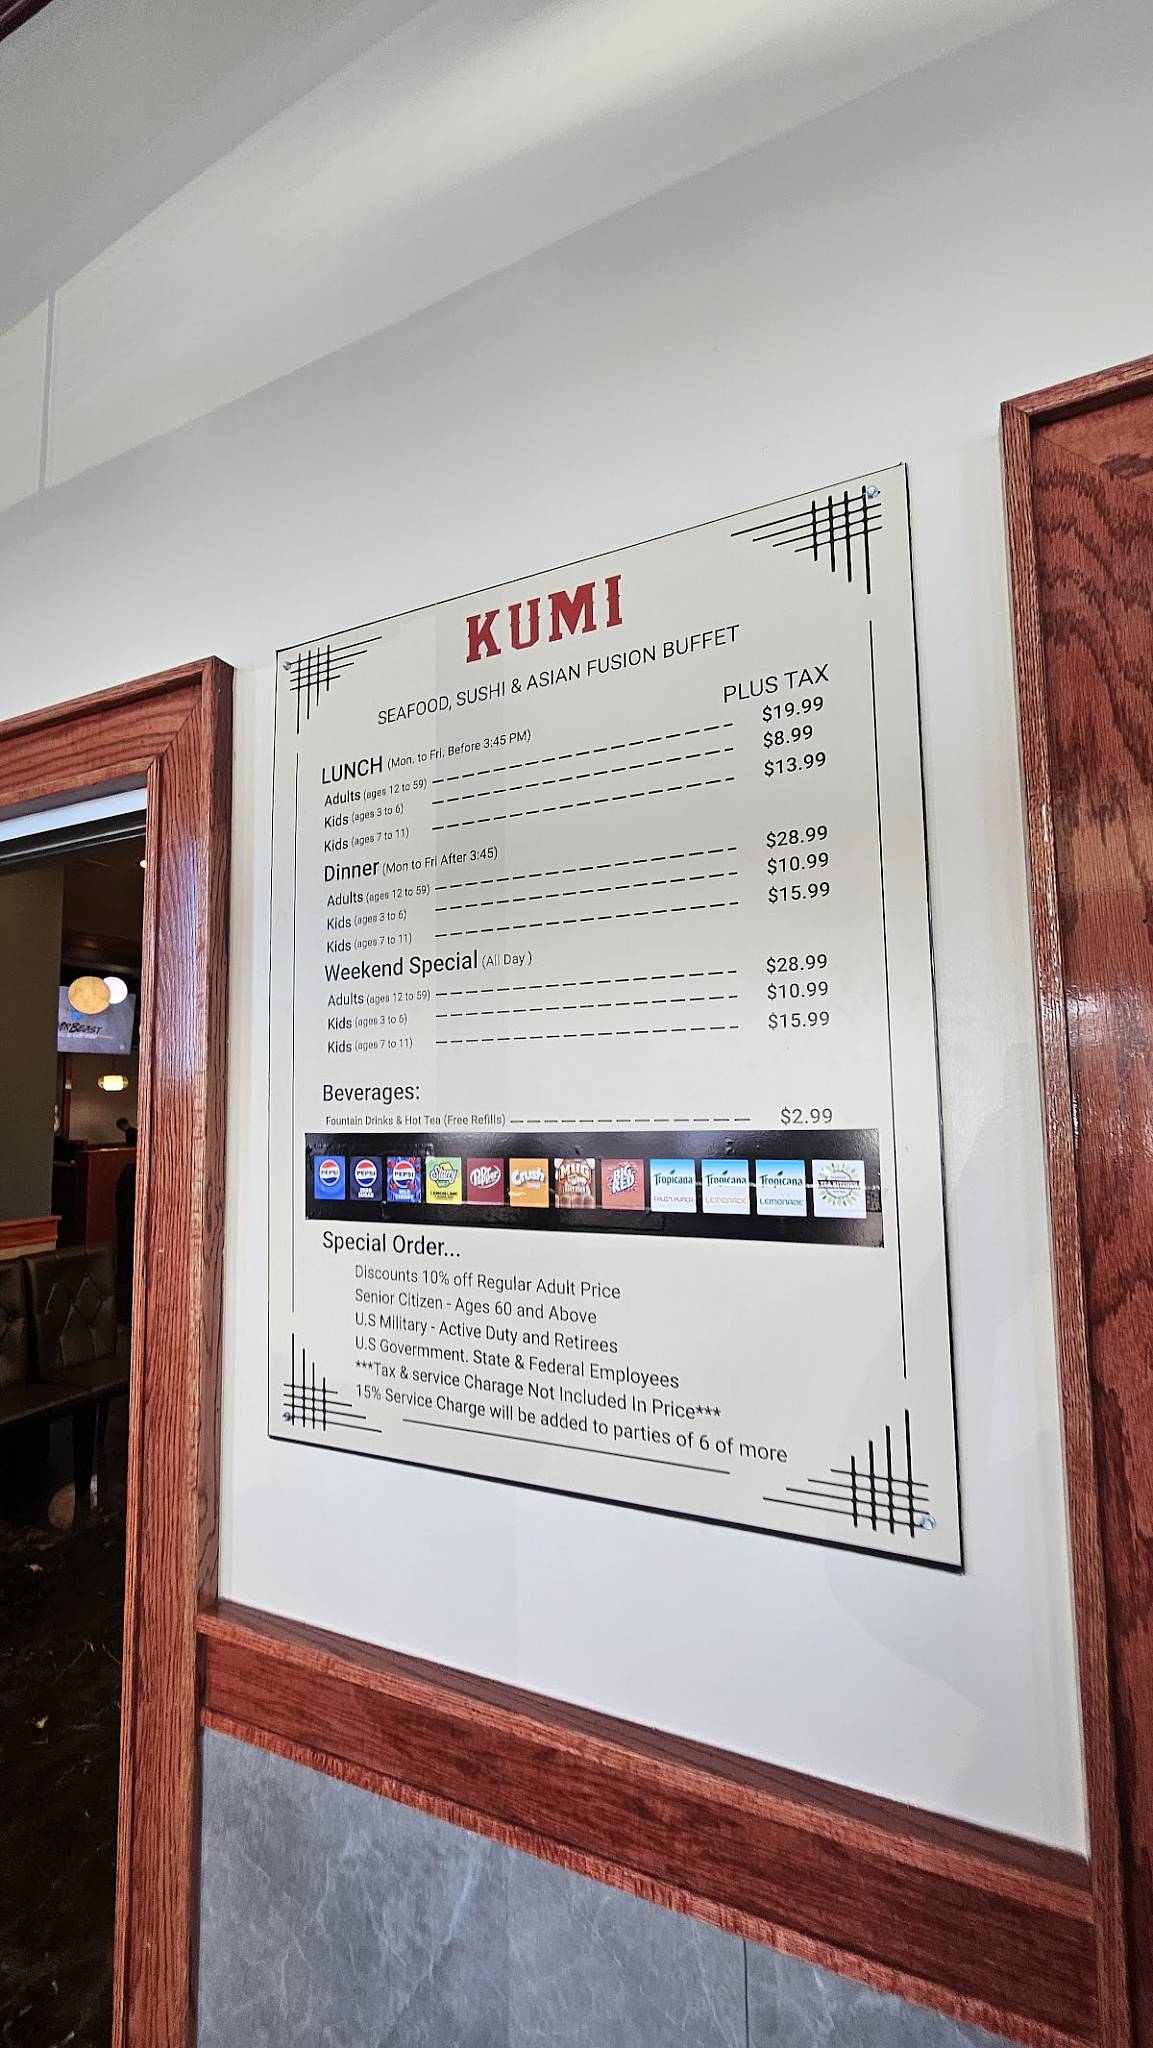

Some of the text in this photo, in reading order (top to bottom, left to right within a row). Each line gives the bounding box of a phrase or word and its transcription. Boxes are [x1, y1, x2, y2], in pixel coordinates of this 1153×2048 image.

[466, 574, 623, 664] KUMI
[378, 624, 740, 725] SEAFOOD, SUSHI & ASIAN FUSION BUFFET
[723, 663, 830, 703] PLUS TAX
[321, 728, 532, 784] LUNCH (Mon. to Fri. Before 3:45 PM)
[324, 696, 824, 807] Adults (ages 12 to 59) $19.99
[324, 725, 814, 829] Kids (ages 3 to 6) $8.99
[324, 751, 827, 853] Kids (ages 7 to 11) $13.99
[324, 846, 498, 882] Dinner (Mon to Fri After 3:45)
[327, 825, 828, 907] Adults (ages 12 to 59) $28.99
[327, 916, 352, 930] Kids
[354, 914, 378, 927] (ages
[379, 911, 385, 922] 3
[387, 910, 396, 921] to
[767, 852, 829, 875] $10.99
[327, 881, 830, 954] Kids (ages 7 to 11) $15.99
[324, 956, 403, 982] Weekend
[409, 949, 478, 978] Special
[482, 953, 500, 970] (All
[327, 993, 364, 1007] Adults
[366, 992, 390, 1006] (ages
[393, 991, 403, 1002] 12
[405, 990, 414, 1002] to
[766, 953, 828, 975] $28.99
[327, 1017, 352, 1030] Kids
[354, 1015, 378, 1028] (ages
[379, 1015, 386, 1025] 3
[388, 1014, 397, 1024] to
[767, 981, 829, 1001] $10.99
[327, 1011, 830, 1053] Kids (ages 7 to 11) $15.99
[323, 1084, 420, 1105] Beverages:
[326, 1106, 833, 1127] Fountain Drinks & Hot Tea (Free Refills) $2.99
[320, 1168, 339, 1176] PEPSI
[512, 1168, 545, 1185] Crush
[560, 1163, 590, 1181] MUG
[612, 1164, 633, 1180] BIG
[612, 1175, 634, 1194] RED
[653, 1173, 693, 1186] Tropicana
[705, 1173, 747, 1187] Tropicana
[759, 1174, 803, 1188] Tropicana
[323, 1231, 460, 1257] Special Order...
[355, 1265, 620, 1299] Discounts 10% off Regular Adult Price
[355, 1289, 597, 1324] Senior Citizen Ages 60 and Above
[355, 1312, 618, 1353] U.S Military Active Duty and Retirees
[355, 1336, 376, 1350] U.S
[473, 1350, 510, 1368] State
[515, 1355, 525, 1369] &
[529, 1357, 584, 1377] Federal
[590, 1364, 679, 1389] Employees
[400, 1366, 408, 1379] &
[412, 1369, 459, 1386] service
[464, 1375, 523, 1397] Charage
[528, 1383, 554, 1400] Not
[560, 1387, 626, 1410] Included
[633, 1398, 646, 1413] In
[356, 1385, 787, 1463] 15% Service Charge will be added to parties of 6 of more
